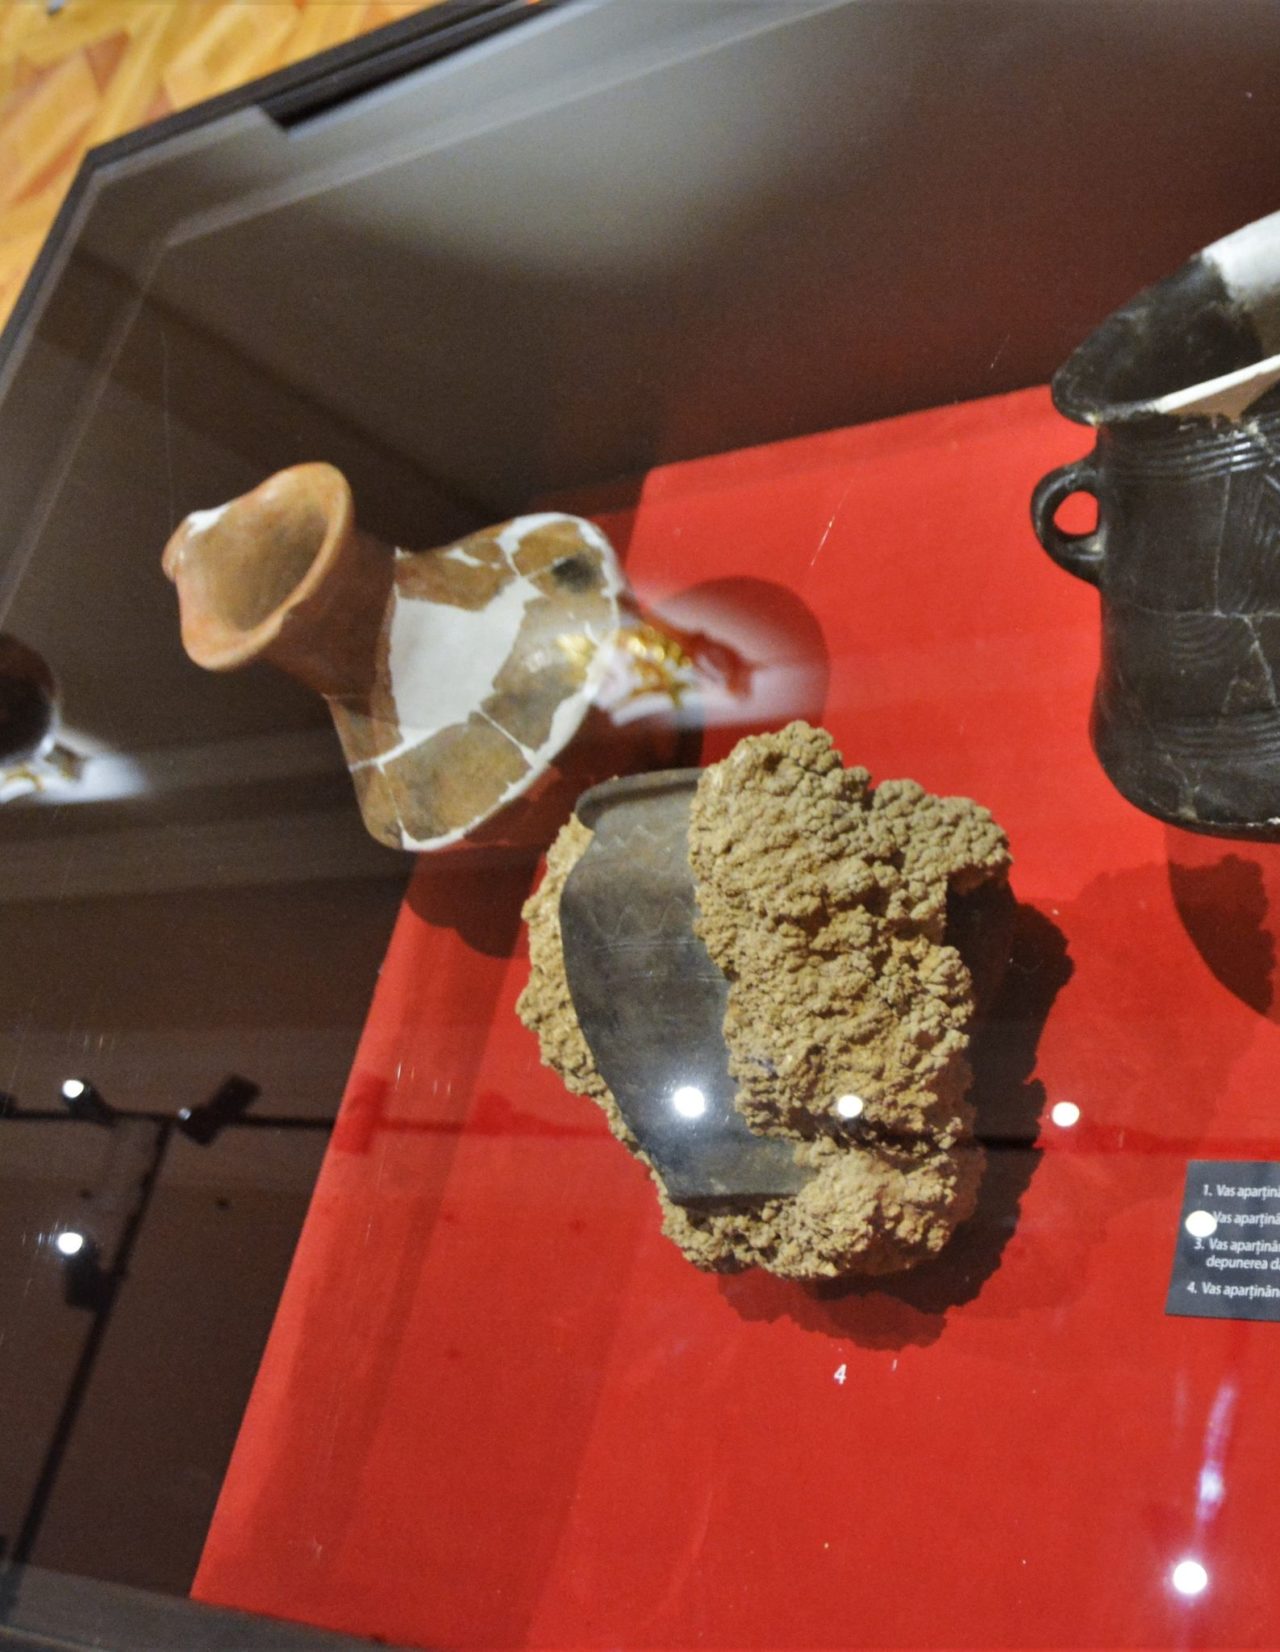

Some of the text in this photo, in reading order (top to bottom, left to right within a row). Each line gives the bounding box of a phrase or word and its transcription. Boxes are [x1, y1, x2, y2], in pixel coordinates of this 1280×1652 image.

[1203, 1184, 1213, 1197] 1.
[1216, 1184, 1235, 1198] Vas
[1209, 1238, 1228, 1251] Vas
[1206, 1255, 1268, 1271] depunerea
[1187, 1281, 1198, 1294] 4.
[1202, 1281, 1221, 1295] Vas
[833, 1362, 847, 1386] 4
